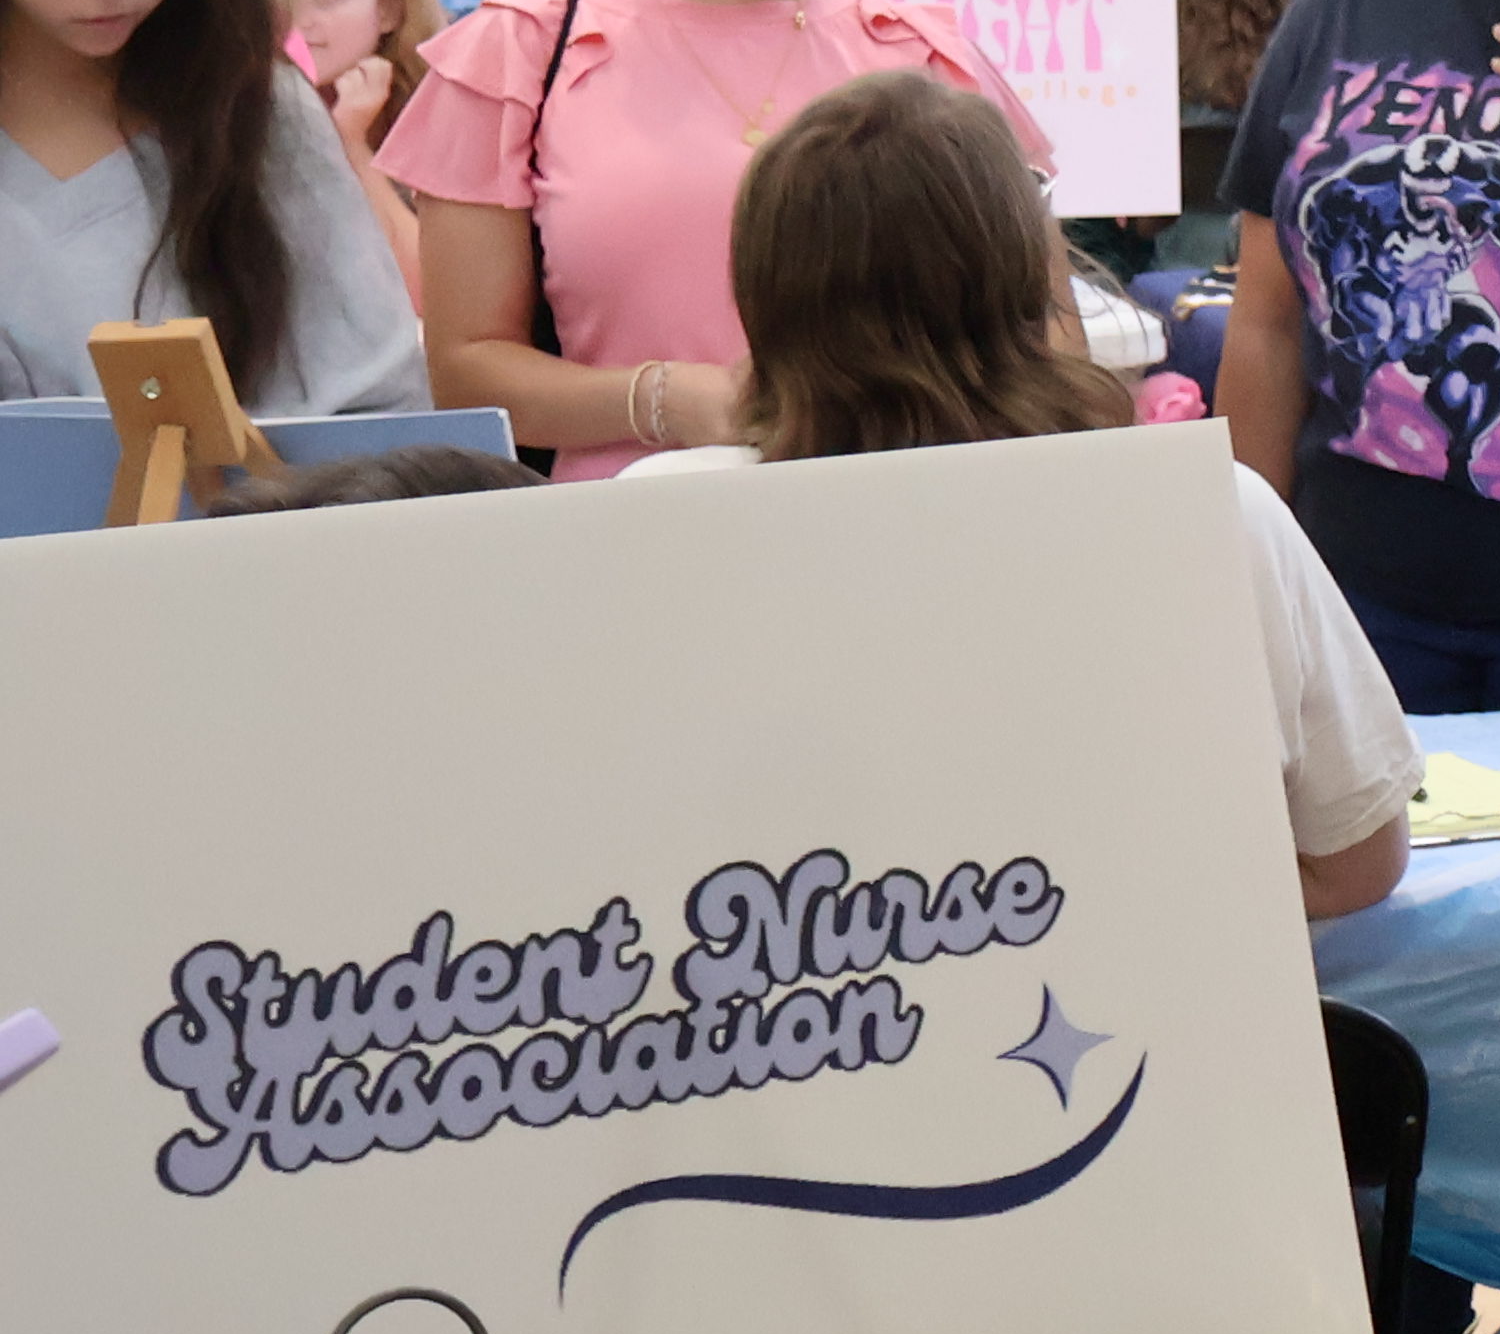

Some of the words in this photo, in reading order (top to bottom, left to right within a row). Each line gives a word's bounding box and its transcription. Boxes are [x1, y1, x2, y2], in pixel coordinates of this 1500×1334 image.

[1018, 79, 1138, 107] ollege
[142, 898, 652, 1092] Student
[672, 848, 1064, 1007] Nurse
[155, 974, 925, 1195] Association
